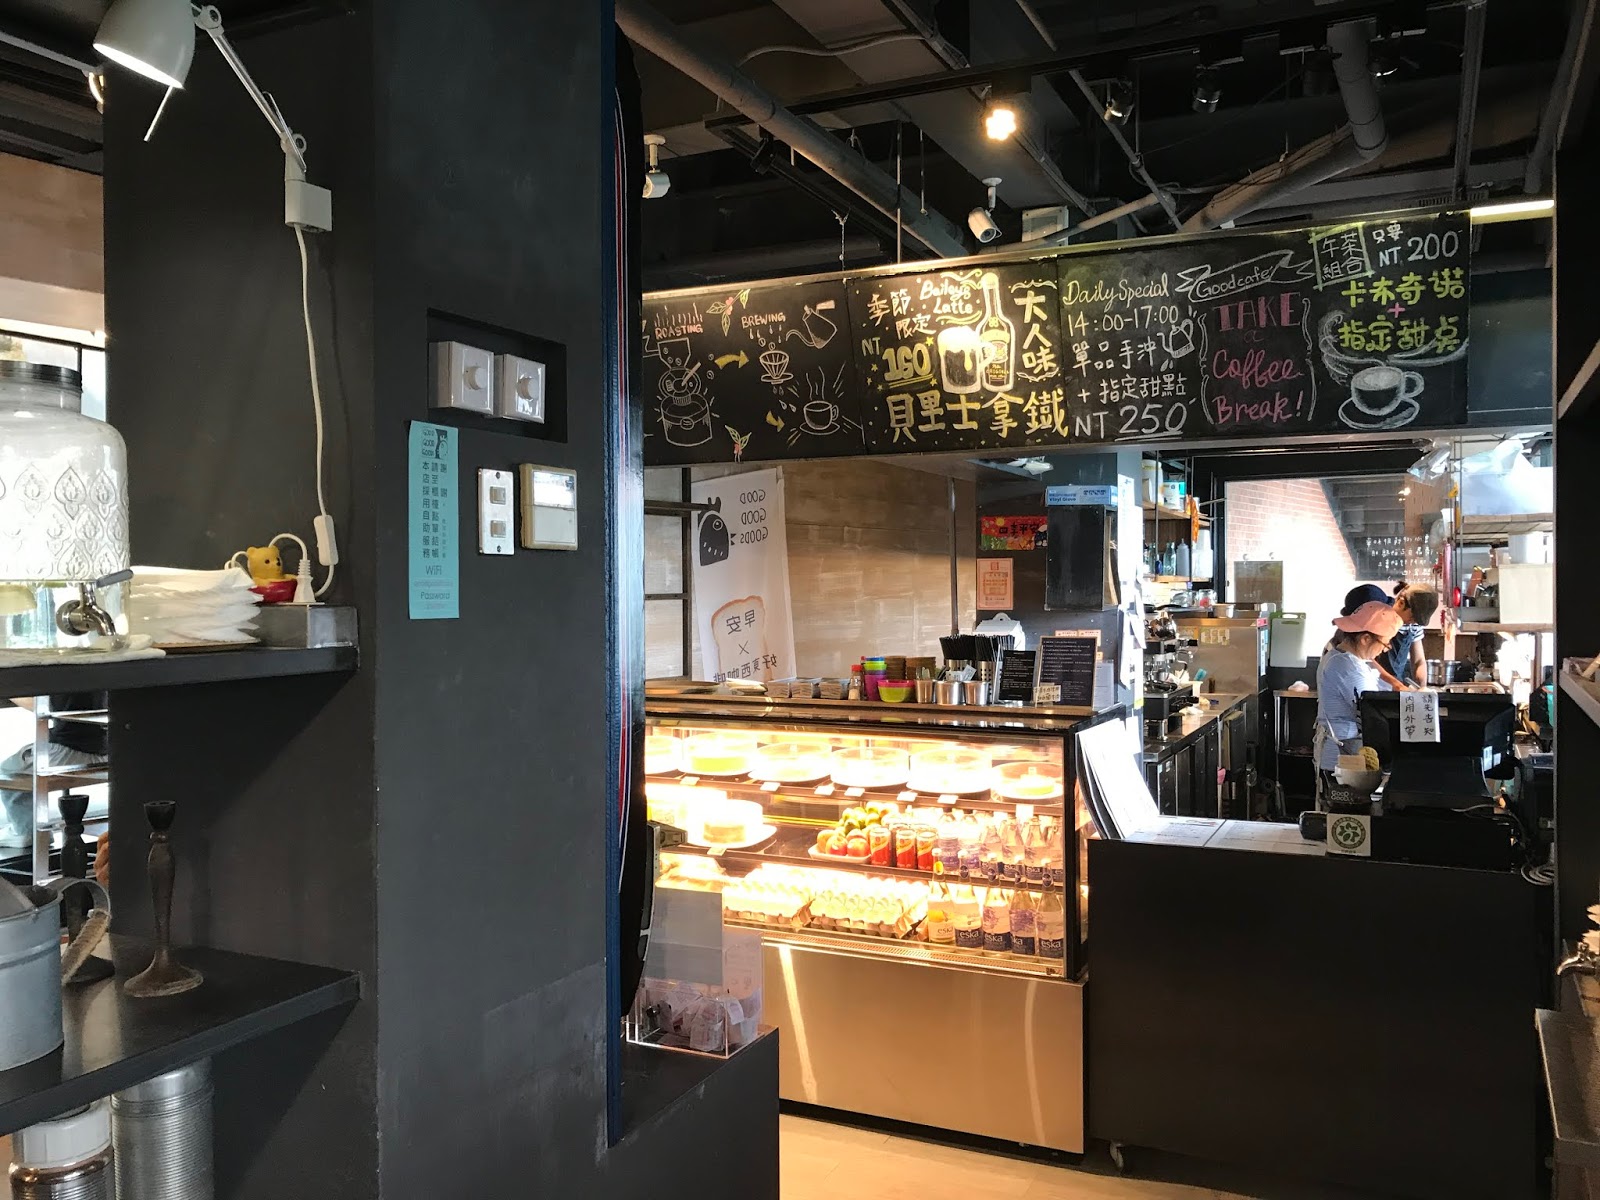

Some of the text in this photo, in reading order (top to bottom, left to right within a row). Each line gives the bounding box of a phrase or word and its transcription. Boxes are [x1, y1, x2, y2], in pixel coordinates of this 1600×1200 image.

[1321, 232, 1363, 258] 午茶
[1372, 220, 1404, 244] 只要
[1322, 256, 1365, 281] 組合
[1063, 272, 1170, 312] Daily Special
[867, 288, 911, 326] 季節
[933, 297, 973, 315] Latte
[1212, 292, 1301, 332] TAKE
[655, 324, 703, 340] ROASTING
[741, 312, 786, 328] BREWING
[896, 313, 936, 340] 限定
[1014, 290, 1057, 374] 大人味
[861, 337, 932, 382] NT 160
[1213, 349, 1305, 389] Coffee
[1212, 390, 1304, 425] Break!
[1075, 411, 1109, 439] NT
[960, 930, 979, 939] eska
[984, 933, 1003, 942] eska
[1041, 939, 1061, 948] eska
